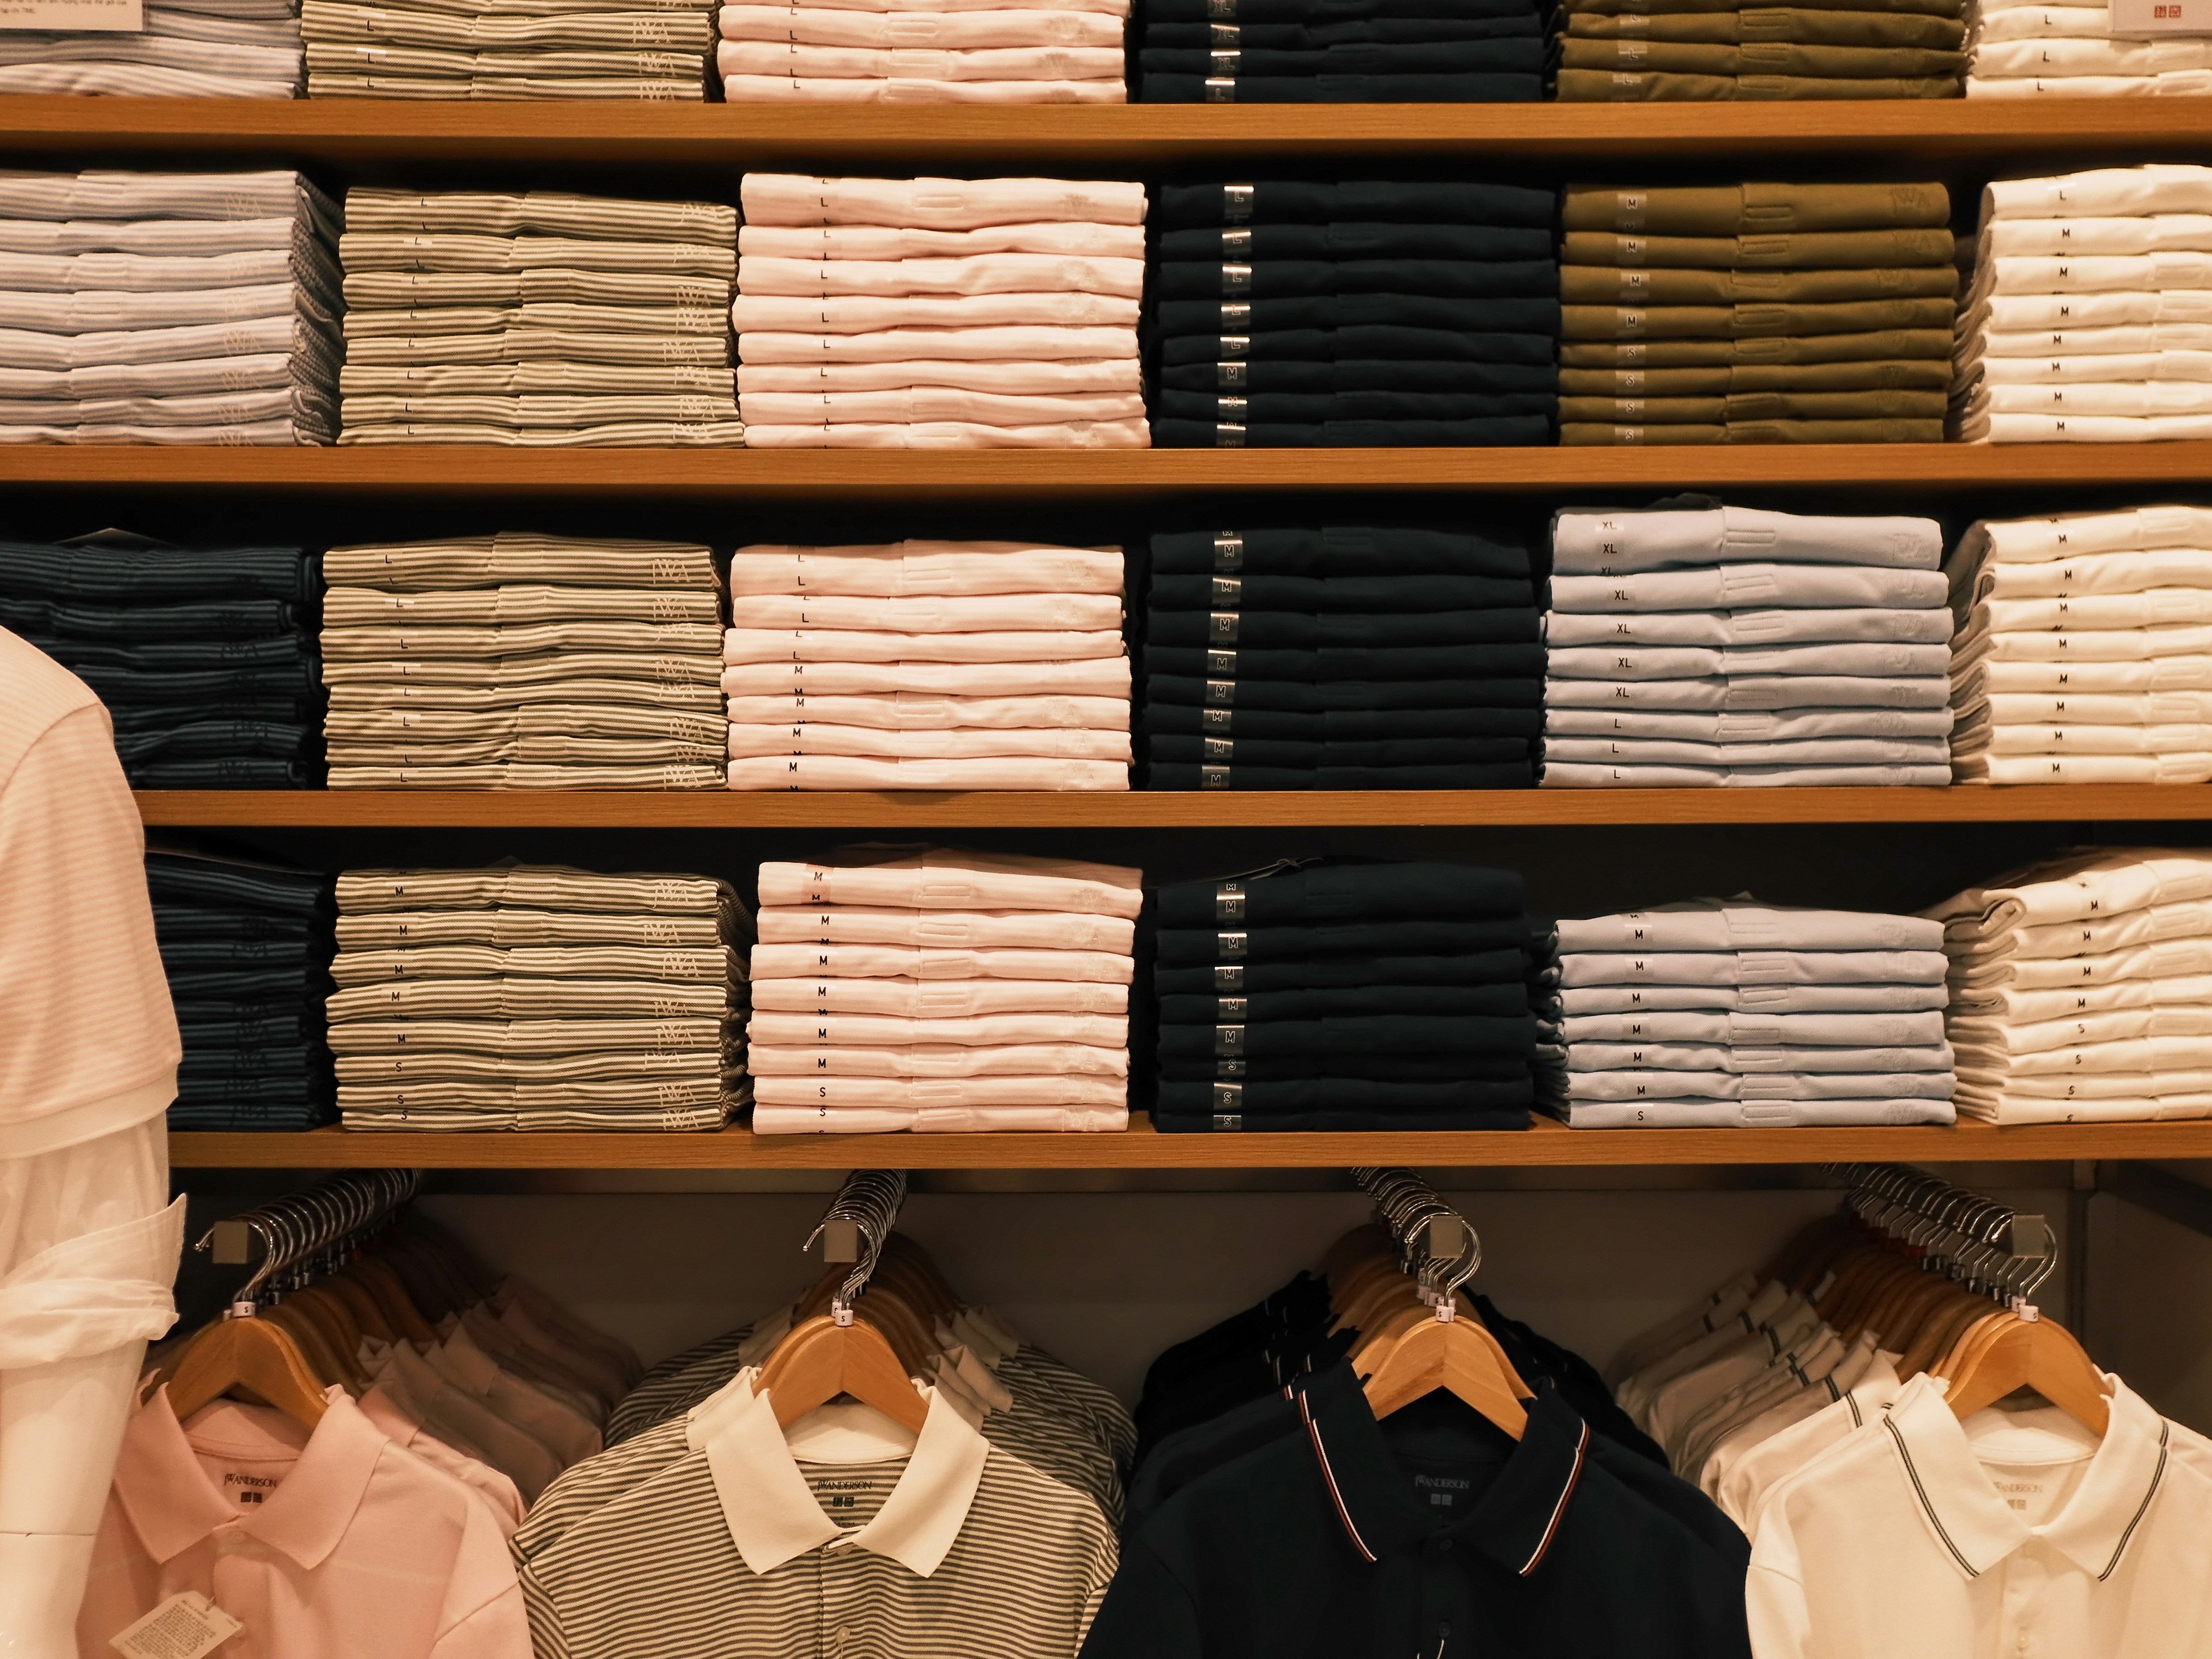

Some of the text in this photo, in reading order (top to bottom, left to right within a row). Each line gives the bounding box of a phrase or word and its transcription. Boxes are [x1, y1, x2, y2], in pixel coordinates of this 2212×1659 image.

[2045, 15, 2052, 25] L
[367, 20, 374, 31] L
[790, 30, 797, 40] L
[791, 45, 797, 53] L
[368, 53, 375, 64] L
[2043, 51, 2050, 62] L
[790, 69, 798, 77] L
[367, 78, 374, 88] L
[794, 80, 800, 88] L
[2037, 81, 2045, 91] L
[1215, 88, 1225, 101] L
[1234, 192, 1244, 202] L
[2060, 191, 2066, 201] L
[420, 198, 427, 206] L
[821, 197, 828, 207] L
[1627, 198, 1637, 209] M
[2062, 229, 2070, 238] M
[1627, 241, 1637, 252] M
[821, 270, 828, 278] L
[1232, 272, 1242, 282] L
[2060, 267, 2067, 277] M
[412, 276, 418, 284] L
[1630, 276, 1641, 287] M
[410, 310, 417, 318] L
[1232, 305, 1241, 315] L
[2061, 307, 2068, 317] M
[822, 312, 829, 322] L
[1627, 315, 1637, 327] M
[408, 339, 415, 347] L
[824, 339, 830, 348] L
[1231, 337, 1241, 349] L
[2053, 335, 2061, 344] M
[1628, 347, 1636, 359] S
[821, 367, 827, 377] L
[2052, 362, 2060, 372] M
[407, 370, 414, 380] L
[1227, 367, 1237, 380] M
[1626, 375, 1634, 387] S
[2054, 392, 2062, 402] M
[405, 402, 412, 412] L
[1626, 402, 1634, 413] S
[408, 425, 414, 434] L
[2057, 422, 2065, 431] M
[1626, 429, 1634, 441] S
[2059, 534, 2067, 543] M
[1224, 545, 1234, 557] M
[1603, 543, 1617, 553] XL
[386, 554, 392, 563] L
[2065, 570, 2072, 580] M
[798, 576, 805, 585] L
[1222, 582, 1232, 593] M
[1614, 590, 1629, 600] XL
[397, 598, 403, 607] L
[2060, 603, 2067, 612] M
[802, 613, 809, 623] L
[1220, 618, 1230, 631] M
[1617, 623, 1630, 633] XL
[401, 639, 408, 649] L
[2059, 639, 2067, 649] M
[793, 651, 800, 659] L
[1217, 658, 1227, 670] M
[1618, 658, 1632, 668] XL
[403, 666, 411, 675] L
[794, 666, 803, 674] M
[2059, 674, 2067, 684] M
[404, 688, 411, 696] L
[1216, 685, 1226, 697] M
[1615, 687, 1629, 698] XL
[797, 698, 804, 707] M
[2057, 702, 2064, 711] M
[1212, 710, 1222, 722] M
[403, 717, 410, 726] L
[1614, 719, 1621, 729] L
[793, 728, 801, 737] M
[2055, 731, 2062, 740] M
[1214, 741, 1224, 753] M
[1612, 743, 1619, 753] L
[789, 762, 797, 772] M
[2052, 763, 2060, 773] M
[400, 772, 407, 782] L
[1614, 769, 1621, 779] L
[1211, 774, 1221, 786] M
[814, 872, 823, 881] M
[395, 886, 403, 896] M
[1226, 900, 1236, 912] M
[2091, 900, 2098, 911] M
[821, 915, 829, 925] M
[399, 925, 407, 935] M
[1635, 930, 1643, 940] M
[2083, 931, 2091, 941] M
[1228, 936, 1238, 948] M
[819, 955, 827, 965] M
[395, 965, 403, 975] M
[1635, 961, 1644, 970] M
[1224, 969, 1234, 979] M
[2083, 967, 2091, 976] M
[818, 986, 826, 996] M
[392, 992, 400, 1001] M
[1632, 993, 1640, 1003] M
[1228, 998, 1238, 1010] M
[2077, 998, 2085, 1008] M
[819, 1029, 826, 1038] M
[1633, 1025, 1640, 1034] M
[2078, 1024, 2085, 1033] S
[397, 1034, 406, 1044] M
[1225, 1031, 1235, 1043] M
[1634, 1052, 1641, 1062] M
[2075, 1055, 2081, 1064] S
[396, 1062, 402, 1072] S
[818, 1058, 826, 1068] M
[1228, 1059, 1236, 1071] S
[819, 1087, 826, 1097] S
[1637, 1085, 1645, 1095] M
[2069, 1086, 2075, 1095] S
[397, 1095, 404, 1104] S
[1223, 1092, 1232, 1104] S
[401, 1110, 408, 1120] S
[819, 1108, 826, 1116] S
[1637, 1111, 1644, 1121] S
[1223, 1116, 1232, 1127] S
